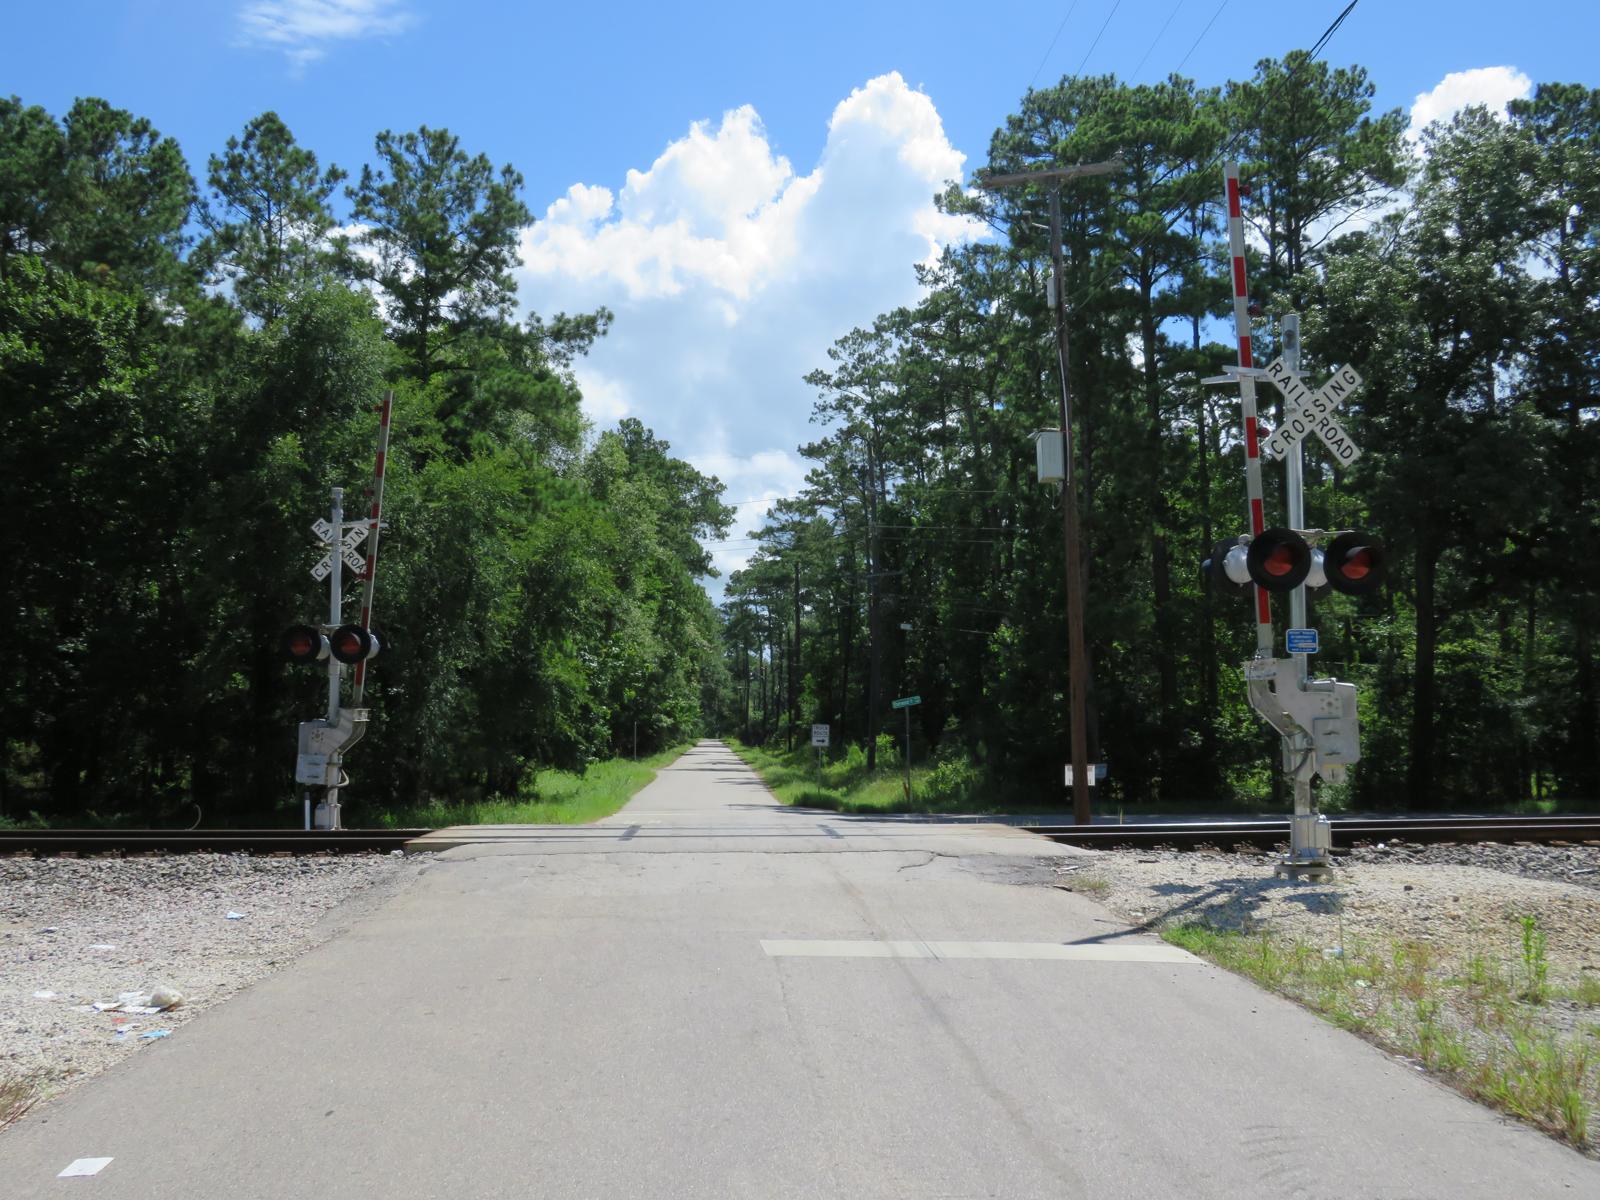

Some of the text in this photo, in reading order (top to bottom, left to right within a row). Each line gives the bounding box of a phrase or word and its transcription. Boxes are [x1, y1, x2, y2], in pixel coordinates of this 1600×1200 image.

[1269, 362, 1353, 460] RAIL ROAD
[1271, 371, 1356, 455] CROSSING
[314, 521, 367, 573] RAI ROA
